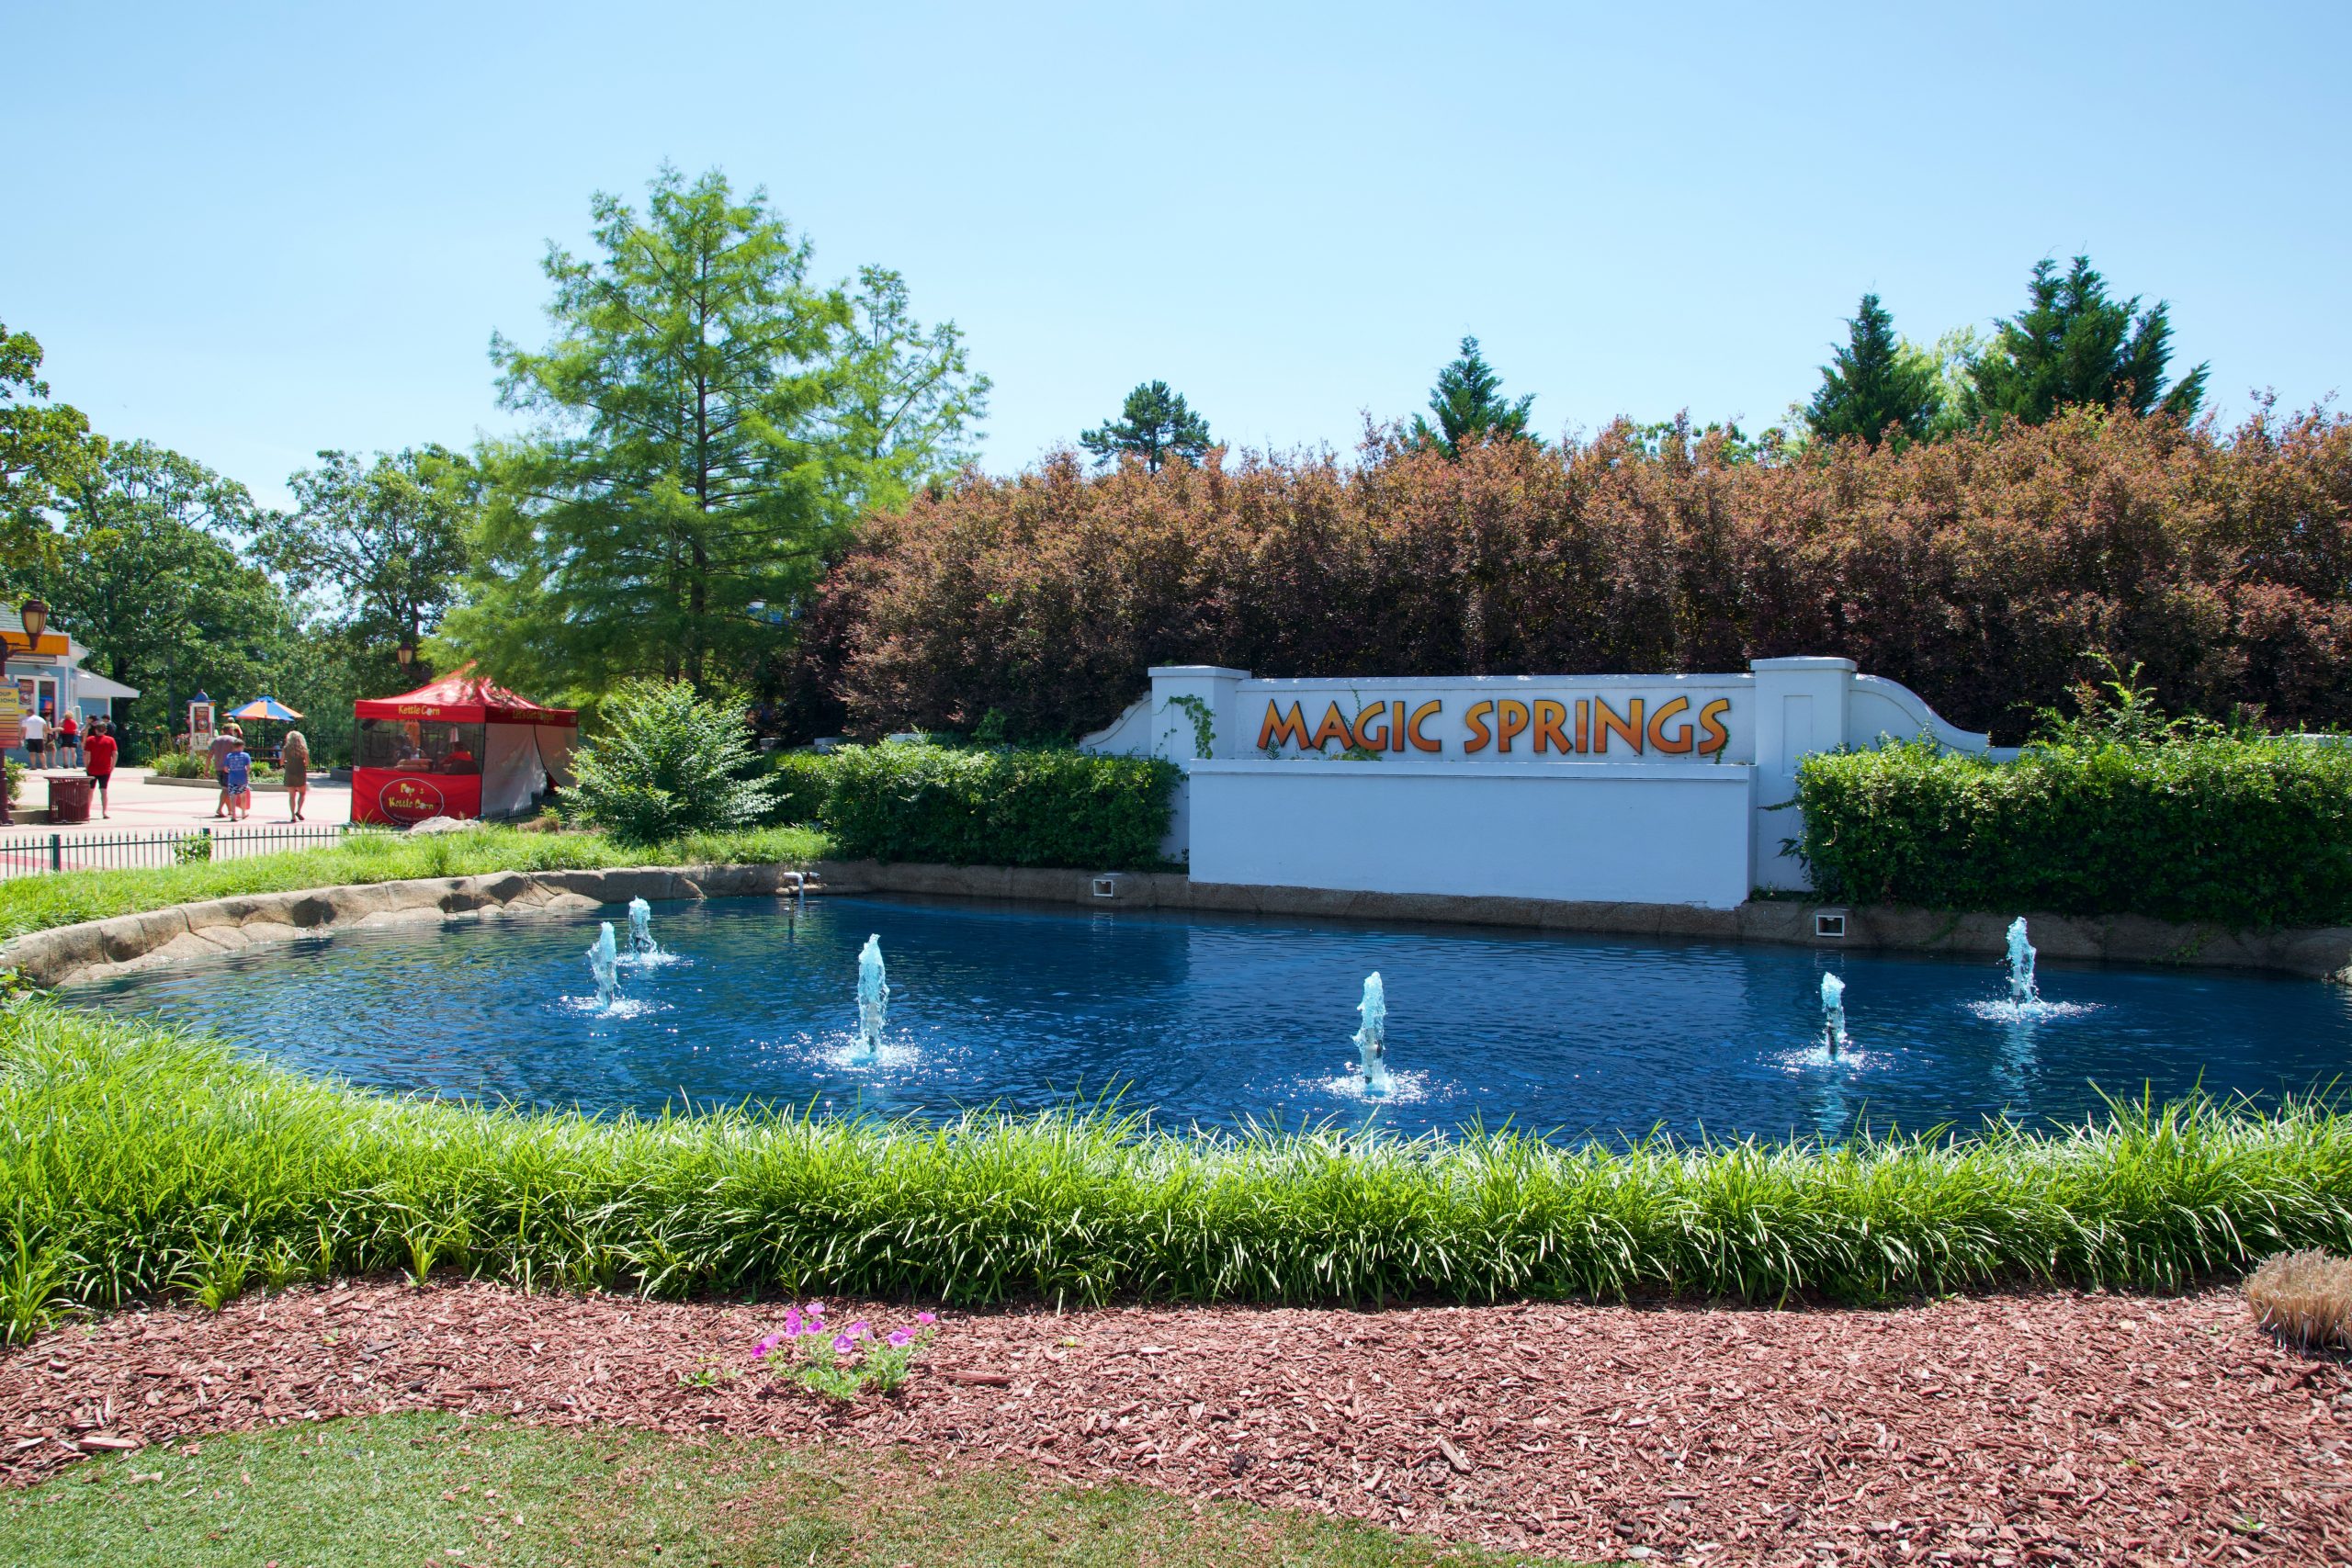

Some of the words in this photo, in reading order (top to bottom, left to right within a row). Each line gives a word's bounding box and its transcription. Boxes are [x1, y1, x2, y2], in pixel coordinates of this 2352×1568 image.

[398, 705, 421, 715] Kettle
[421, 705, 441, 716] Corn
[1257, 698, 1442, 751] MAGIC
[1464, 695, 1731, 756] SPRINGS
[401, 783, 424, 796] Pops
[389, 796, 413, 808] Kettle
[414, 798, 434, 810] Corn
